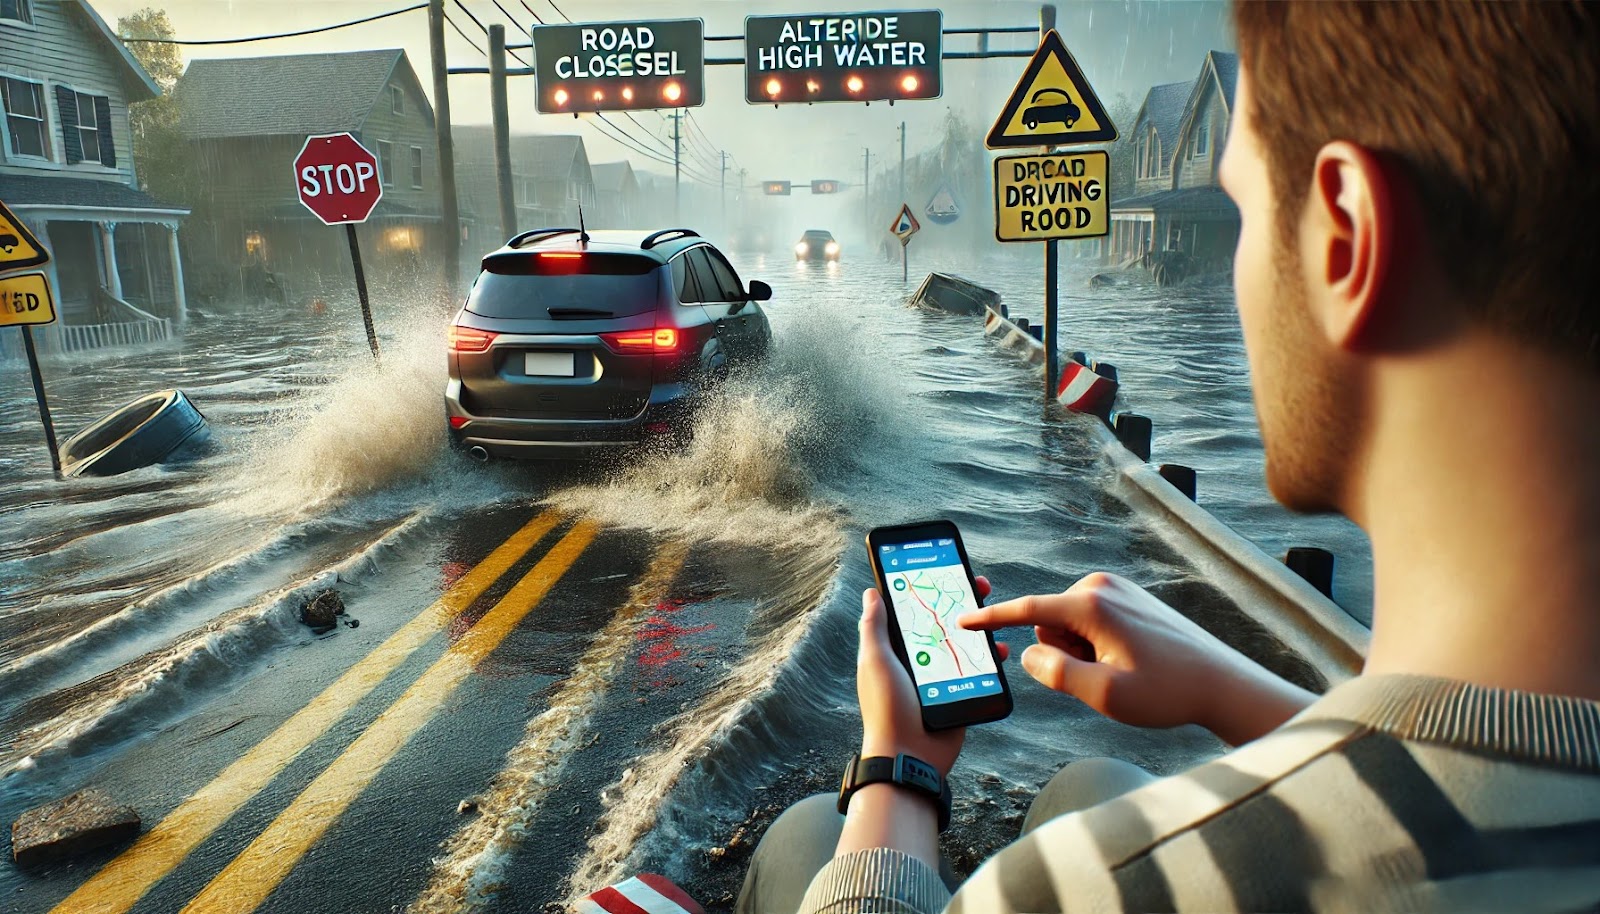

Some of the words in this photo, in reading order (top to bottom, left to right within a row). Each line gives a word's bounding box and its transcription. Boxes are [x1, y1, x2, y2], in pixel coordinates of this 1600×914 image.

[581, 27, 655, 52] ROAD
[758, 44, 823, 70] HIGH
[833, 41, 926, 67] WATER
[301, 162, 375, 197] STOP
[1005, 180, 1102, 208] DRIVING
[1021, 206, 1091, 232] ROOD
